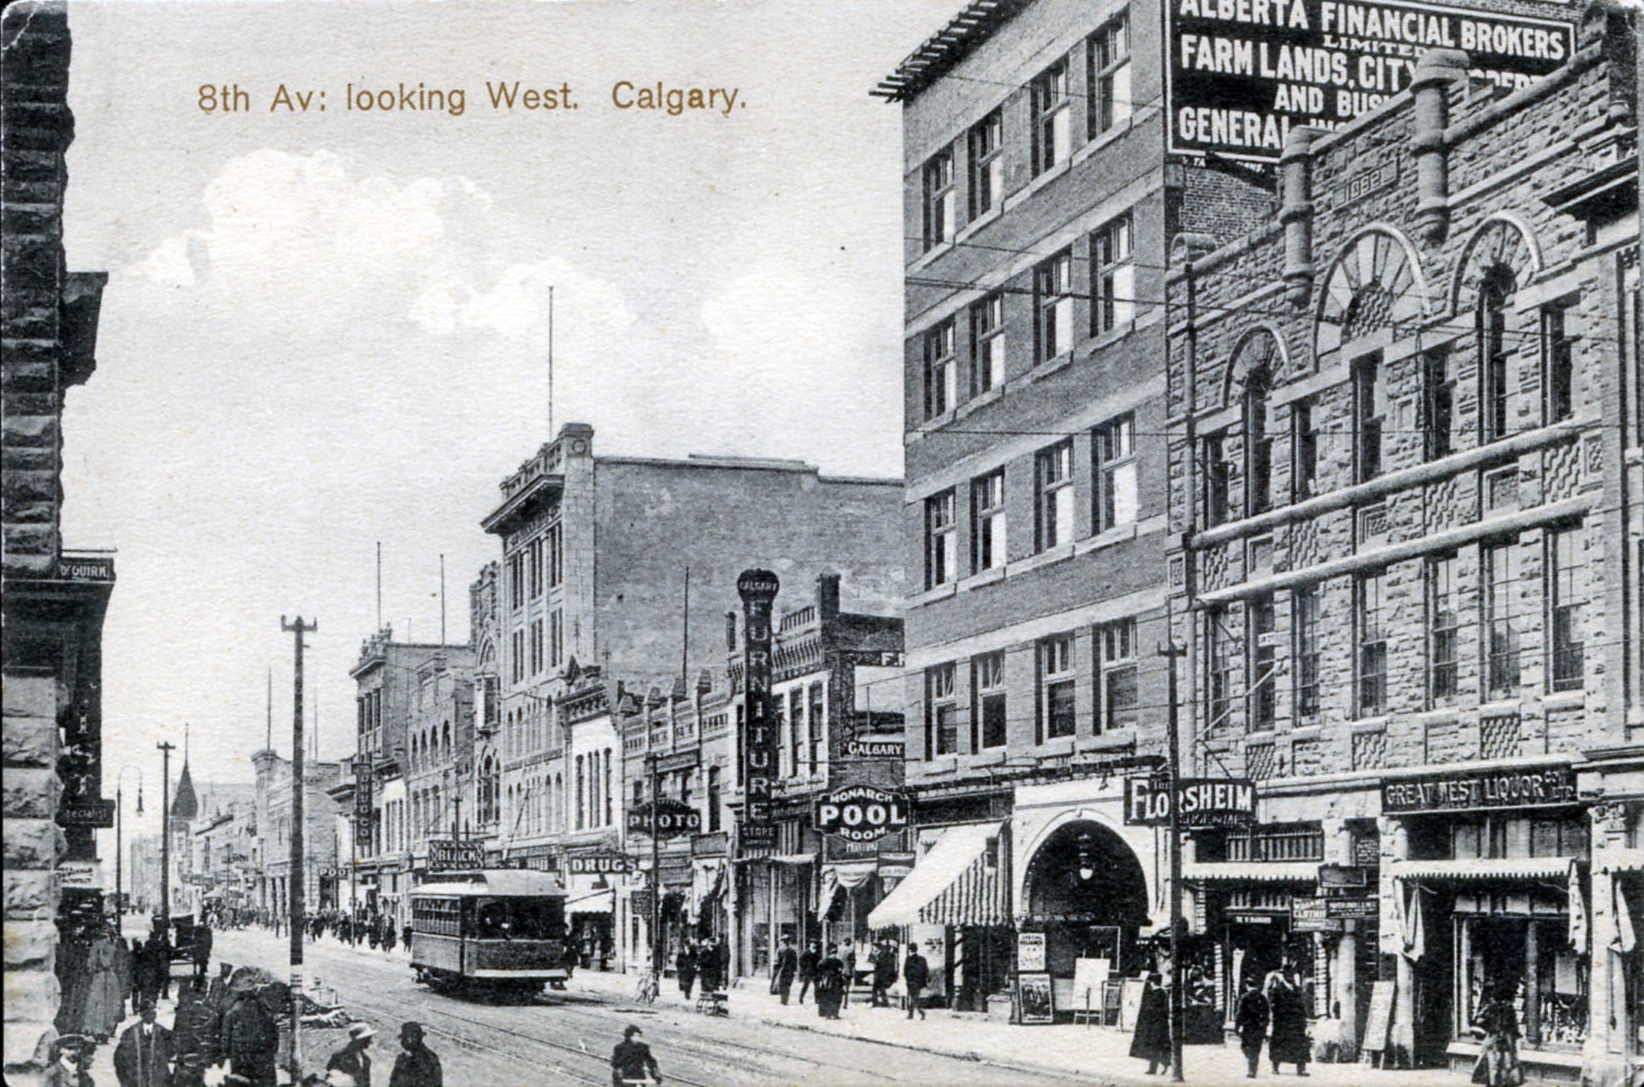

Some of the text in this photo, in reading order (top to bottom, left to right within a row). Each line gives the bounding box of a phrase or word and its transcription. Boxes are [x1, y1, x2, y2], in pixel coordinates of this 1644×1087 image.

[1179, 0, 1565, 61] ALBERTA FINANCIAL BROKERS
[1322, 34, 1428, 58] LIMITED
[1180, 34, 1253, 76] FARM
[1259, 42, 1355, 89] LANDS,
[1274, 84, 1391, 119] AND BUS
[1178, 107, 1291, 149] GENERAL
[749, 599, 770, 819] FURNITURE
[848, 741, 903, 755] CALGARY
[829, 787, 893, 803] MONARCH
[1386, 783, 1436, 805] GREAT
[1438, 779, 1480, 801] WEST
[1484, 774, 1546, 801] LIQUOR
[628, 813, 700, 828] PHOTO
[819, 804, 907, 826] POOL
[840, 826, 886, 840] ROOM
[571, 858, 638, 872] DRUGS
